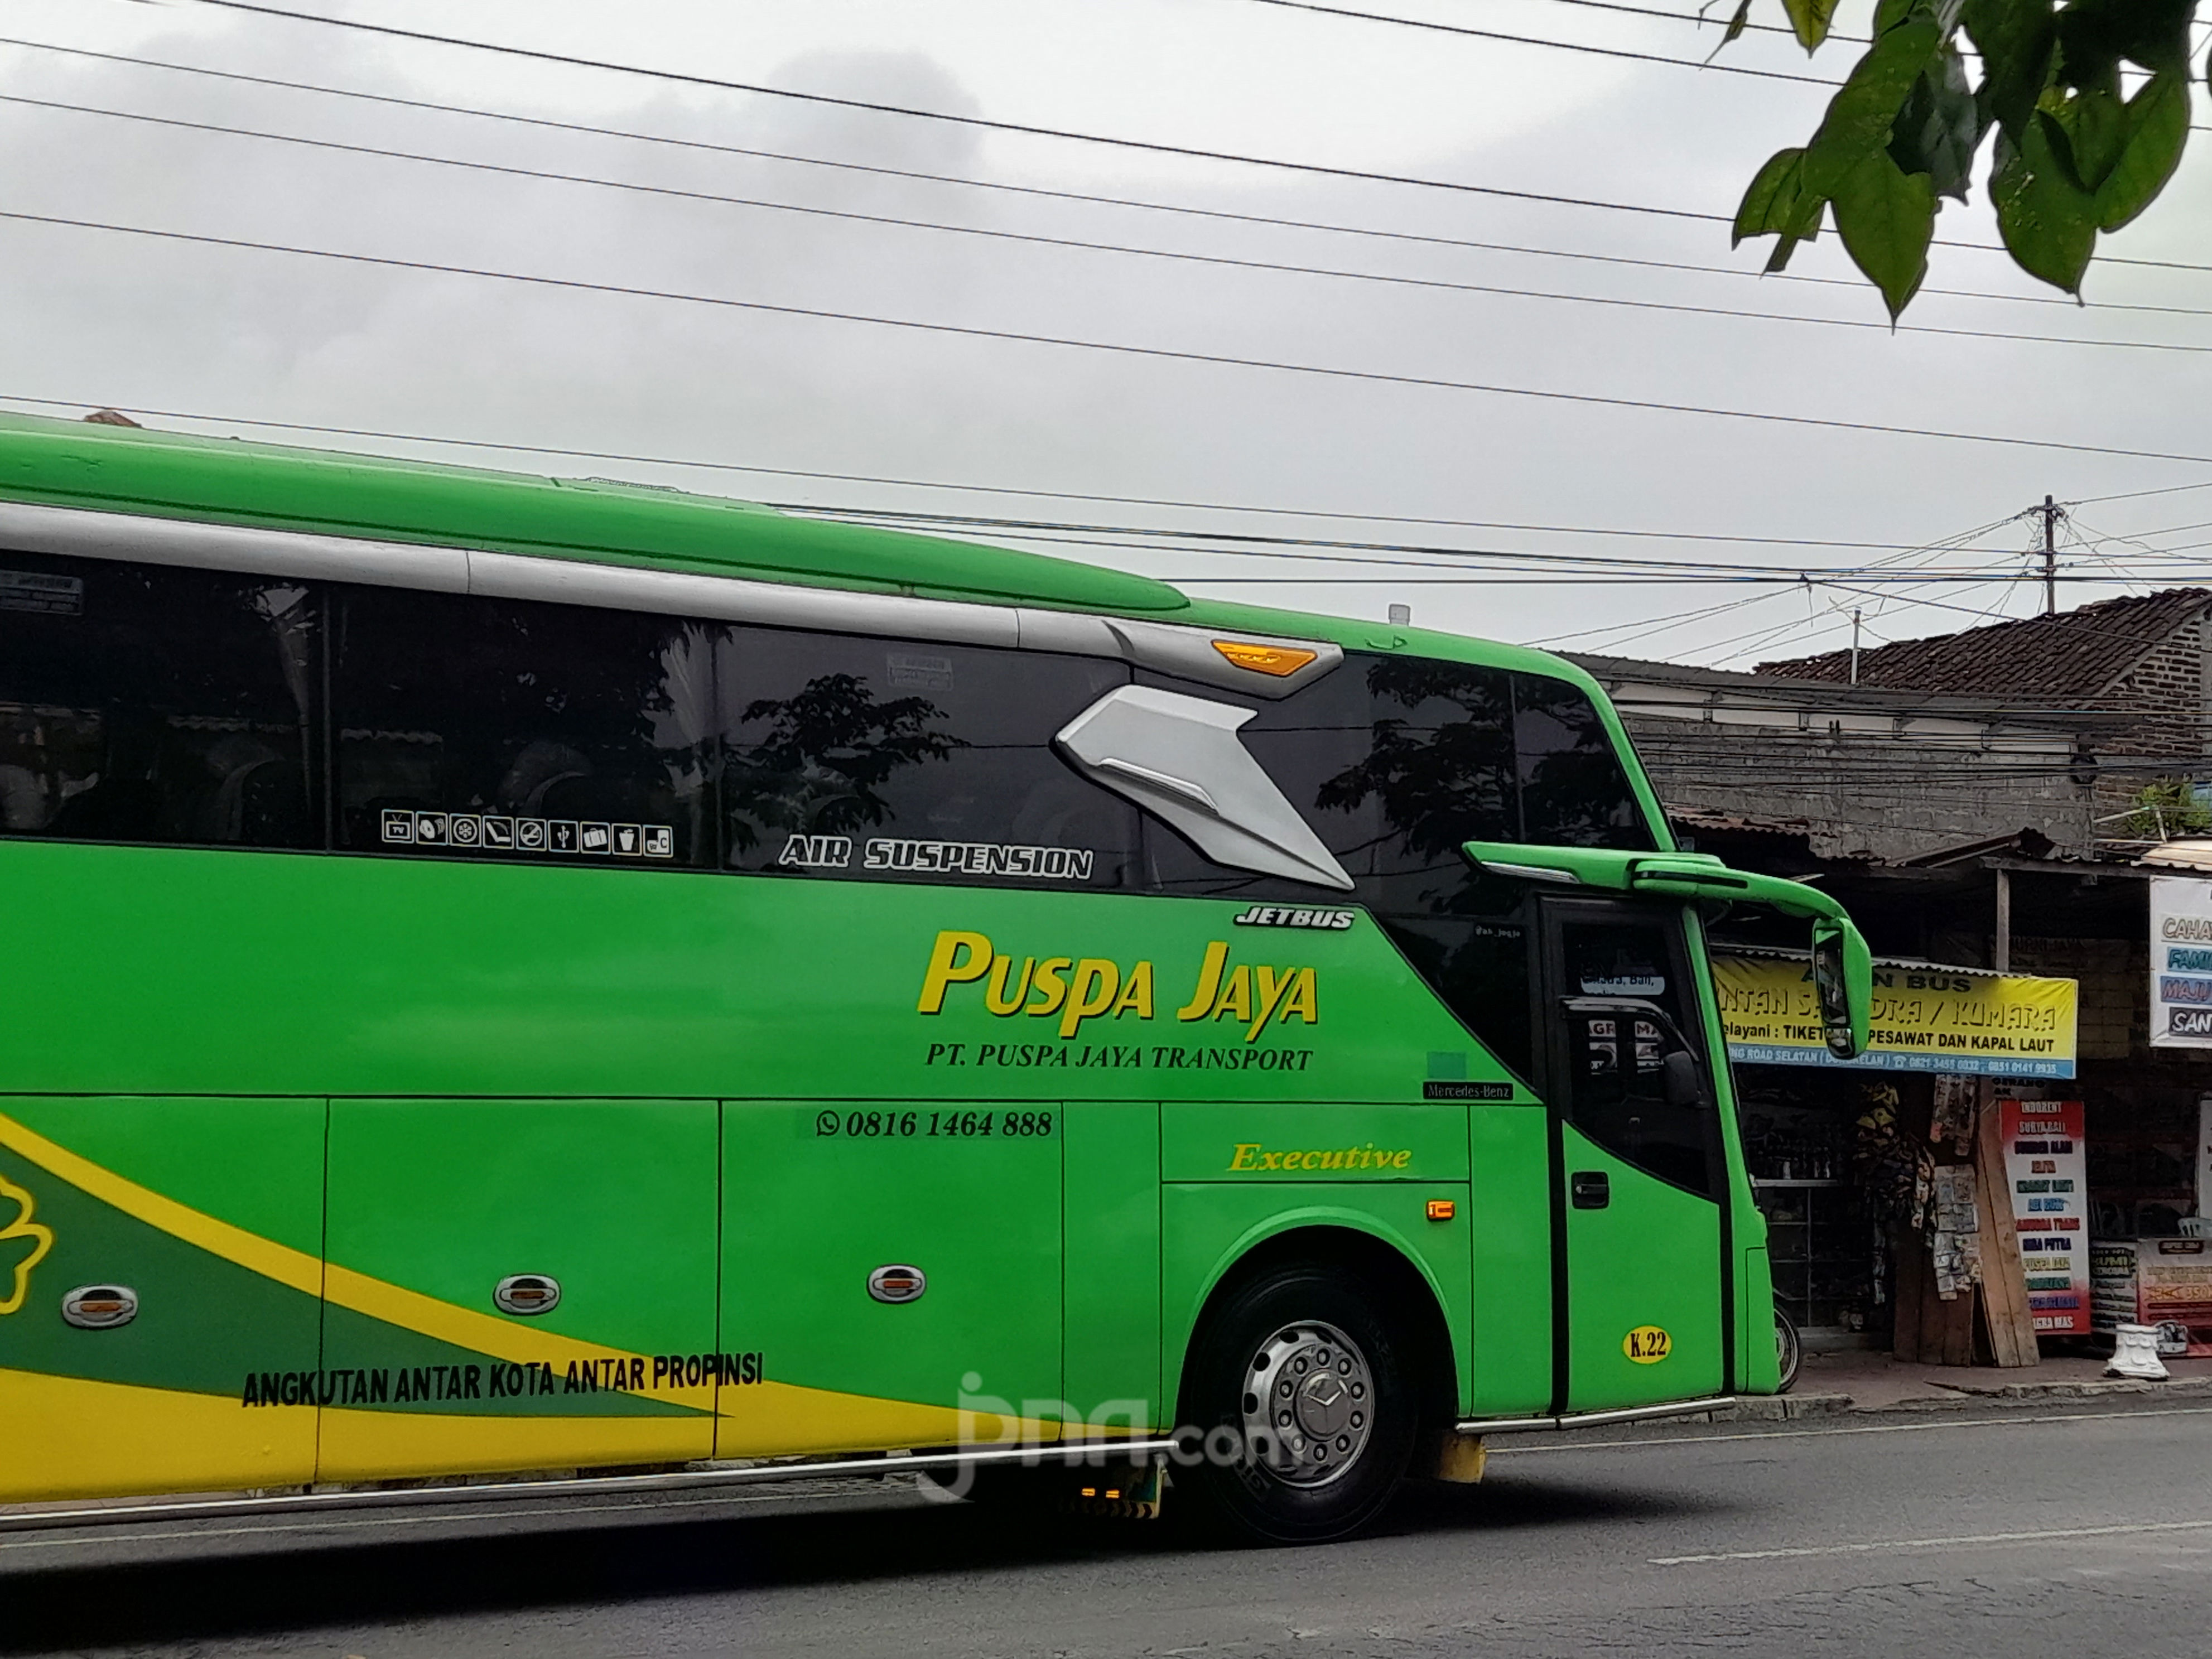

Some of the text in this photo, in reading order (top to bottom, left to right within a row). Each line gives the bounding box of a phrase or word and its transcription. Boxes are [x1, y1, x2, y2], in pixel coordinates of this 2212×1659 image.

[779, 835, 1093, 880] AIR SUSPENSION
[1234, 906, 1355, 930] JETBUS
[2162, 918, 2212, 941] CAHA
[1907, 975, 1971, 992] BUS
[1951, 1000, 2055, 1031] KUMARA
[1723, 1022, 1770, 1040] elayani
[1784, 1025, 1823, 1040] TIKET
[1868, 1030, 1934, 1046] PESAWAT
[1939, 1034, 1967, 1048] DAN
[1971, 1036, 2015, 1050] KAPAL
[2020, 1038, 2055, 1052] LAUT
[924, 1043, 1313, 1072] PT. PUSPA JAYA TRANSPORT
[1747, 1048, 1773, 1060] ROAD
[1428, 1084, 1509, 1098] Mercedes-Benz
[846, 1111, 1053, 1137] 0816 1464 888
[1226, 1142, 1411, 1171] Executive
[1631, 1332, 1666, 1357] K.22
[242, 1352, 763, 1408] ANGKUTAN ANTAR KOTA ANTAR PROPINSI
